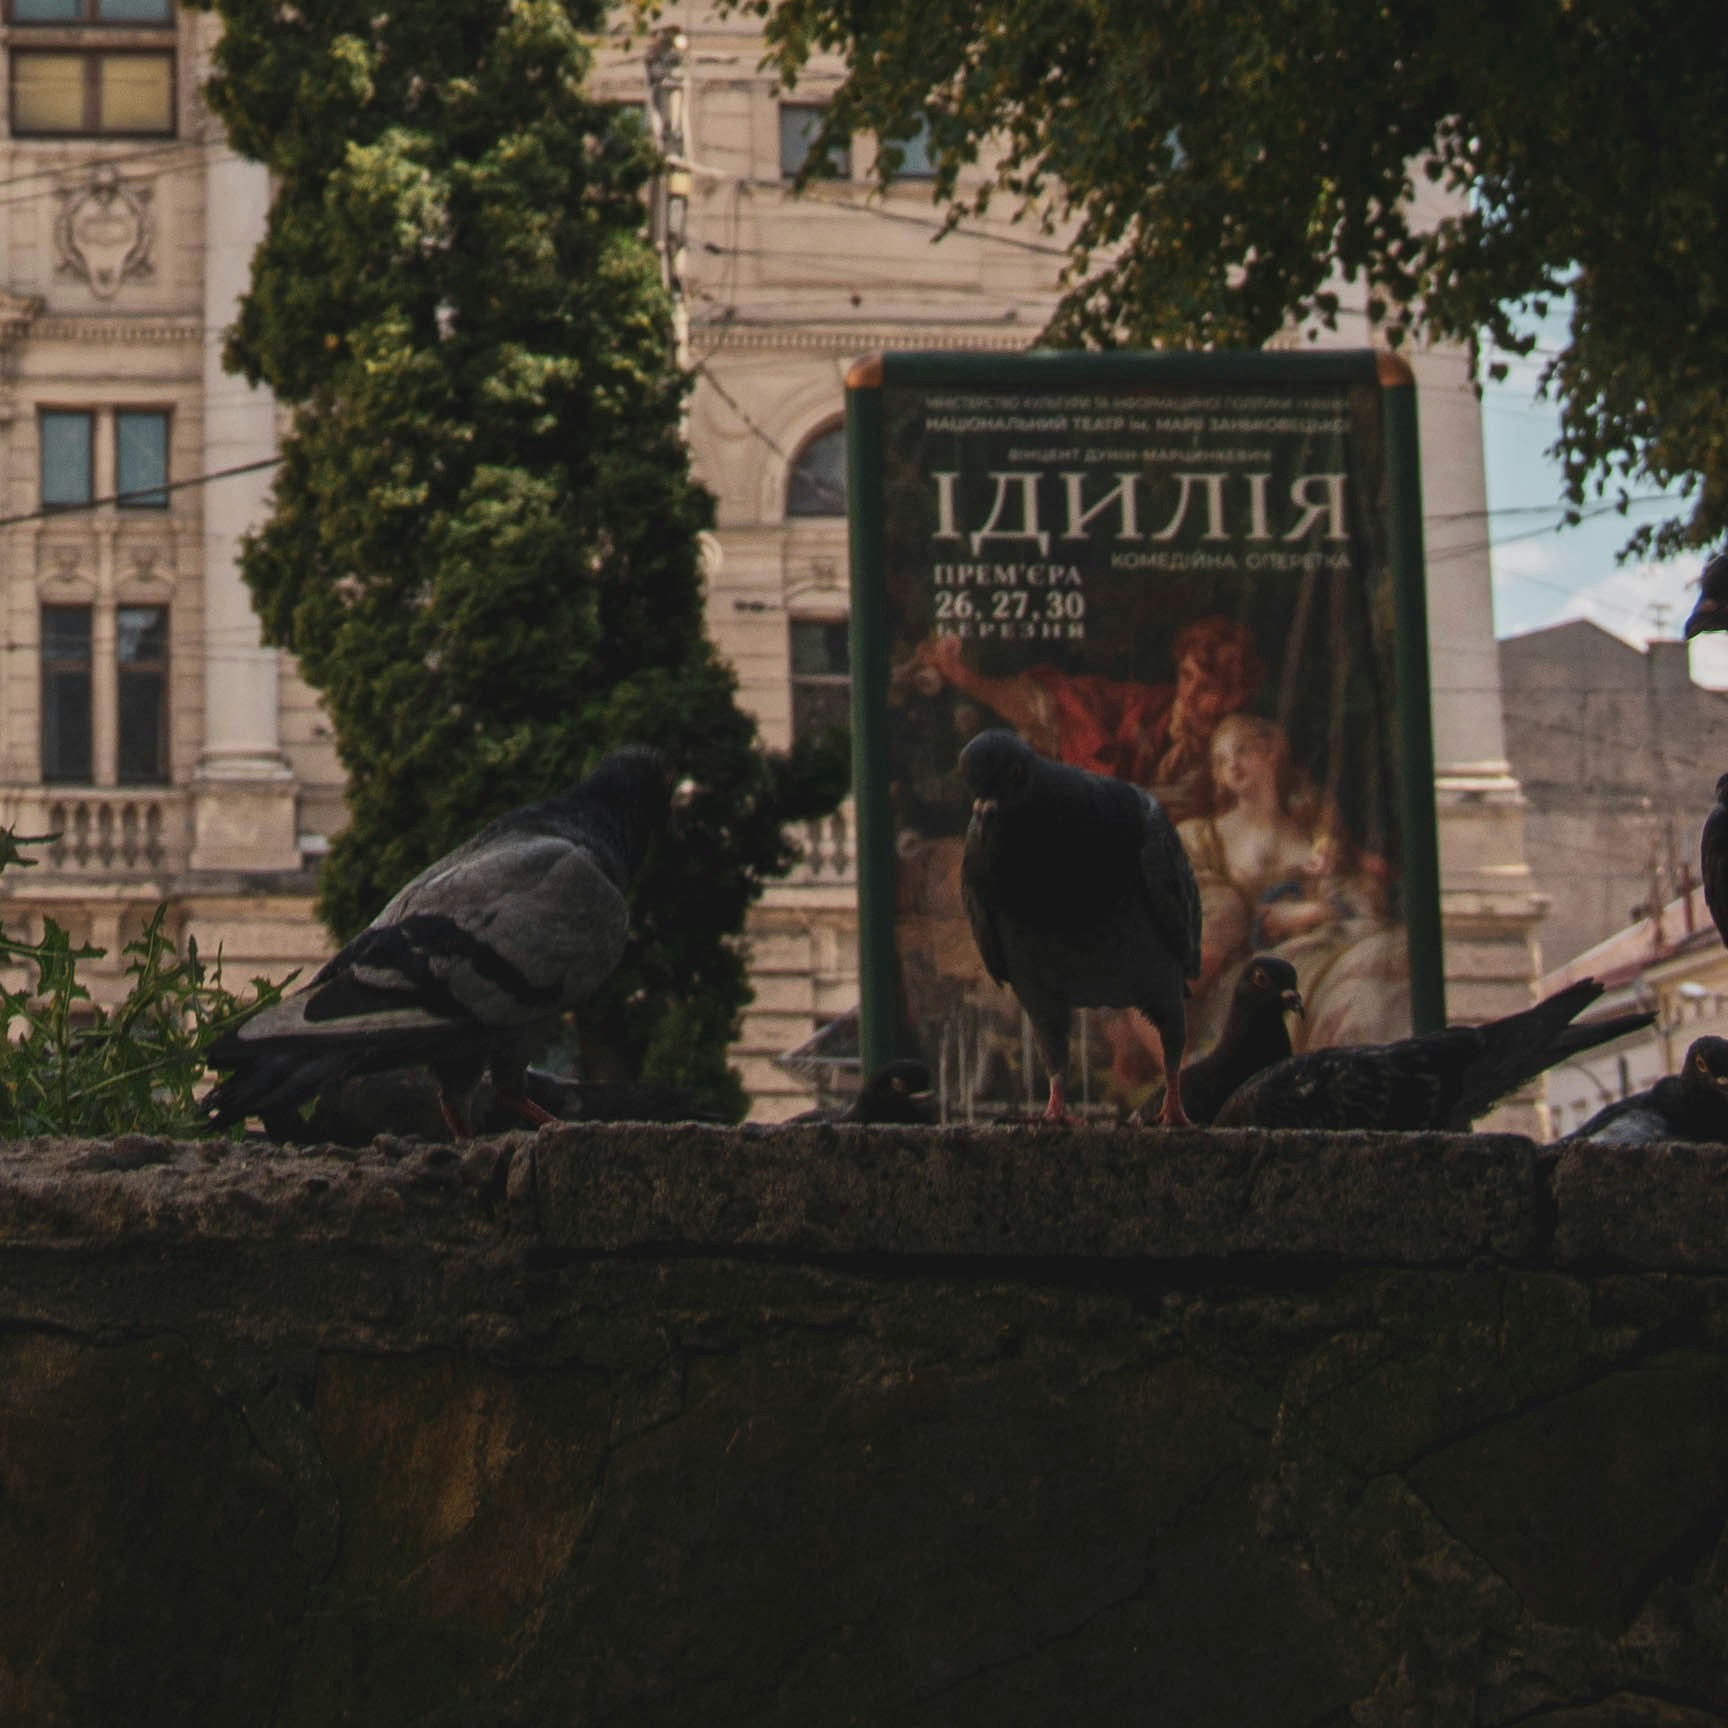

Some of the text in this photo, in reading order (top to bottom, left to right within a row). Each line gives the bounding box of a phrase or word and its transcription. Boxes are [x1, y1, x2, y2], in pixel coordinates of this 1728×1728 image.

[1072, 416, 1125, 432] ТЕАТР
[931, 470, 1350, 558] ІДИЛІЯ
[1111, 549, 1352, 570] КОМЕДІЙНА ОПЕРЕТКА
[1046, 590, 1086, 619] 30
